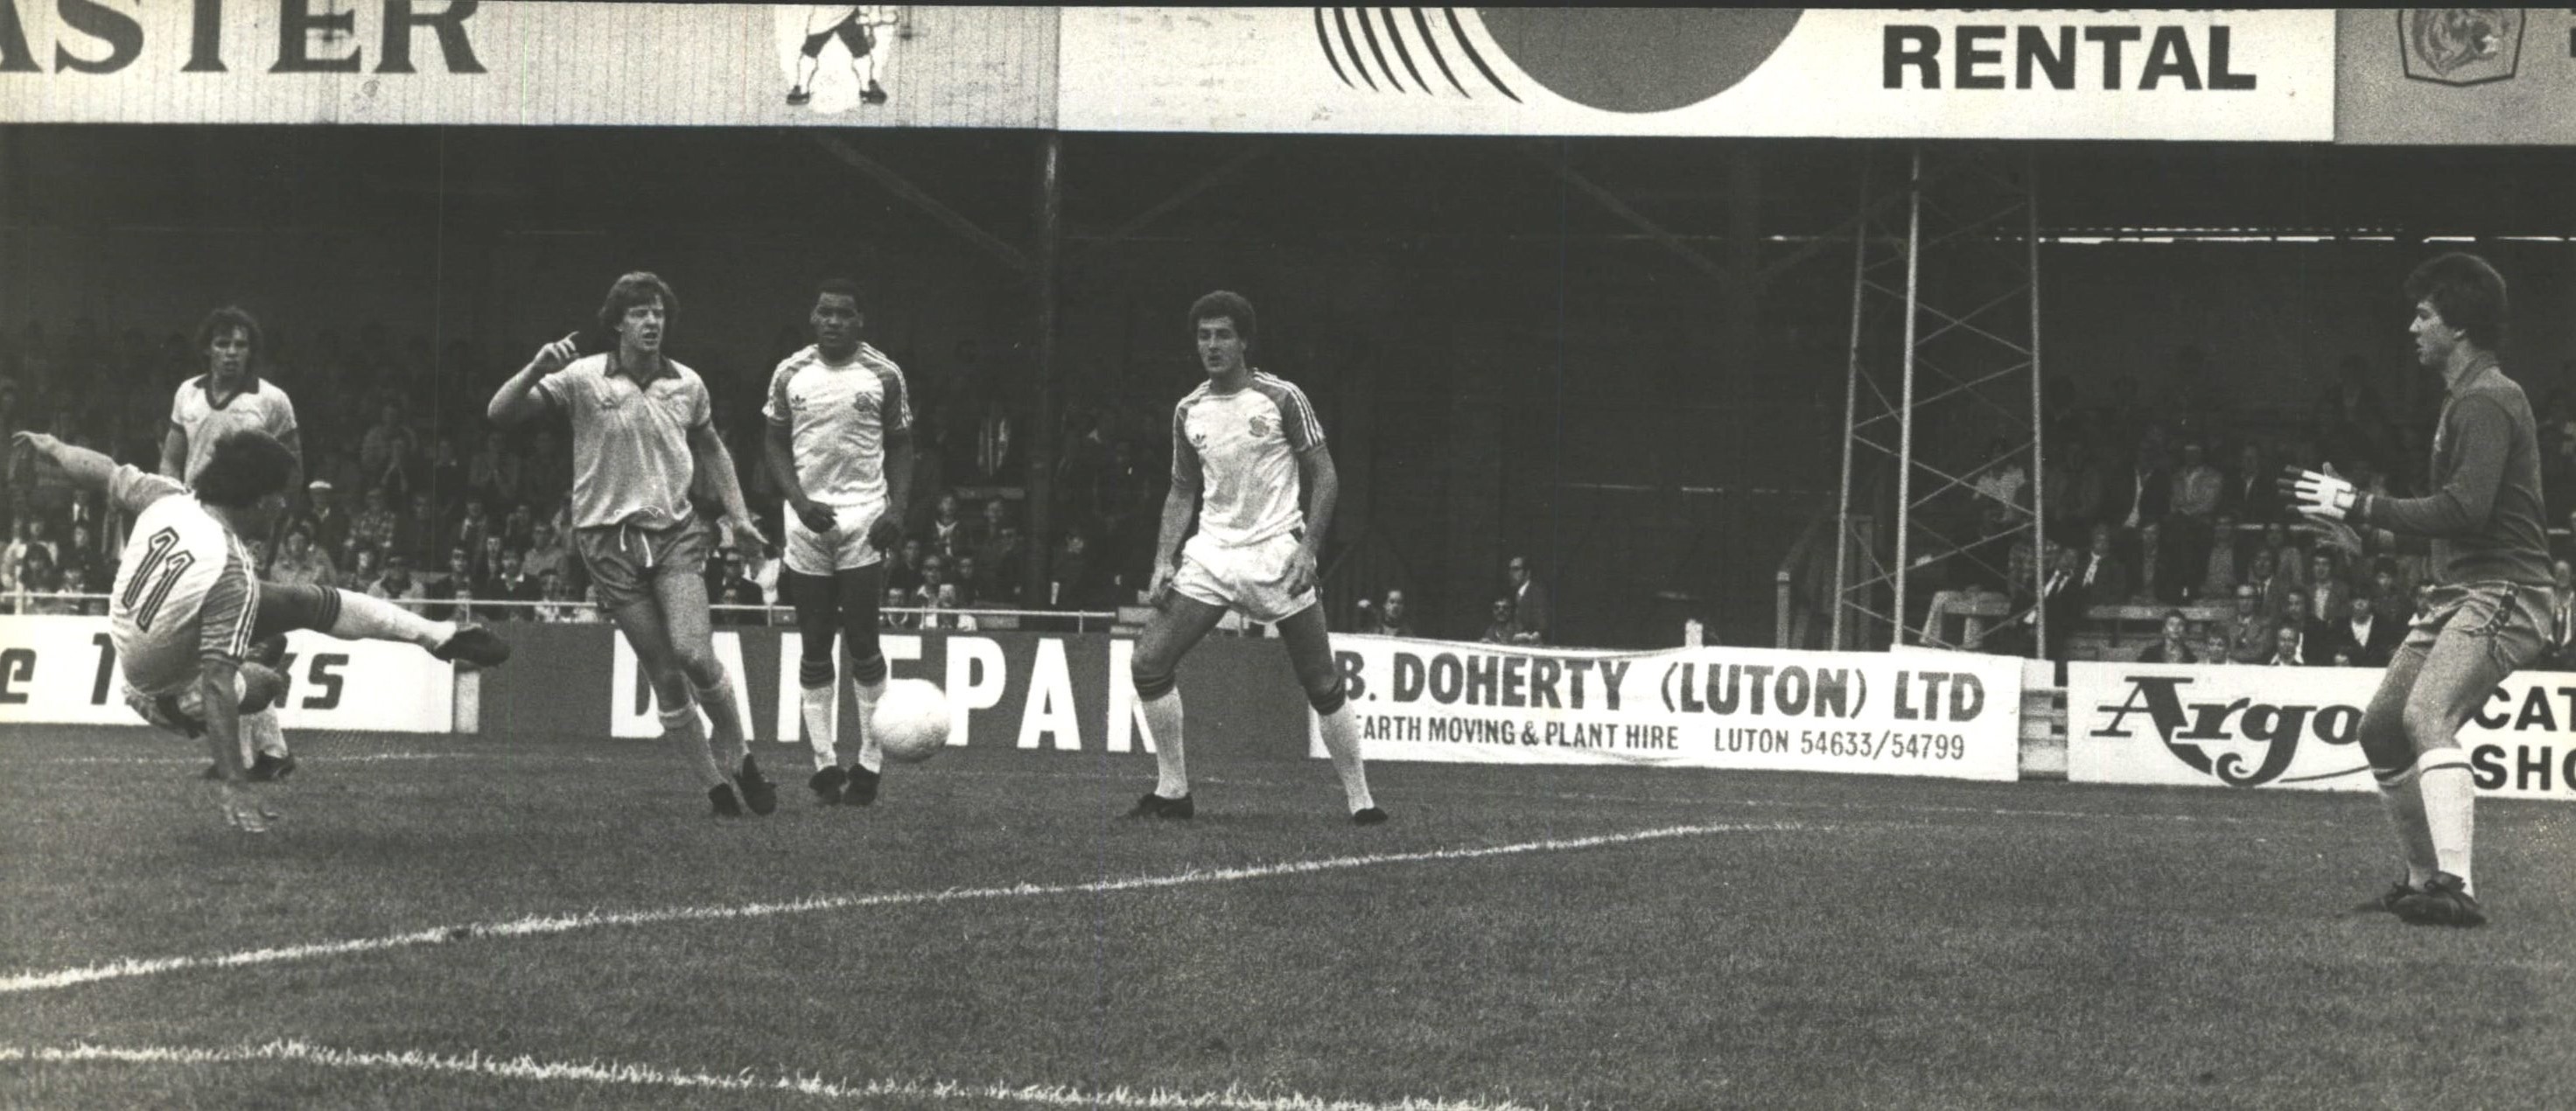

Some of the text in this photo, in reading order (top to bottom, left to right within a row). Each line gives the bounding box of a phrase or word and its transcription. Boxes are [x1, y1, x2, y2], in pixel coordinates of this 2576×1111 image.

[1882, 24, 2258, 92] RENTAL
[122, 527, 195, 633] 11
[1334, 650, 1984, 723] B. DOHERTY (LUTON) LTD
[1428, 716, 1516, 745] MOVING
[1521, 722, 1540, 746] &
[1544, 721, 1619, 750] PLANT
[1625, 724, 1679, 751] HIRE
[1714, 728, 1789, 753] LUTON
[1800, 729, 1965, 760] 54633/54799
[2090, 675, 2369, 786] Argo
